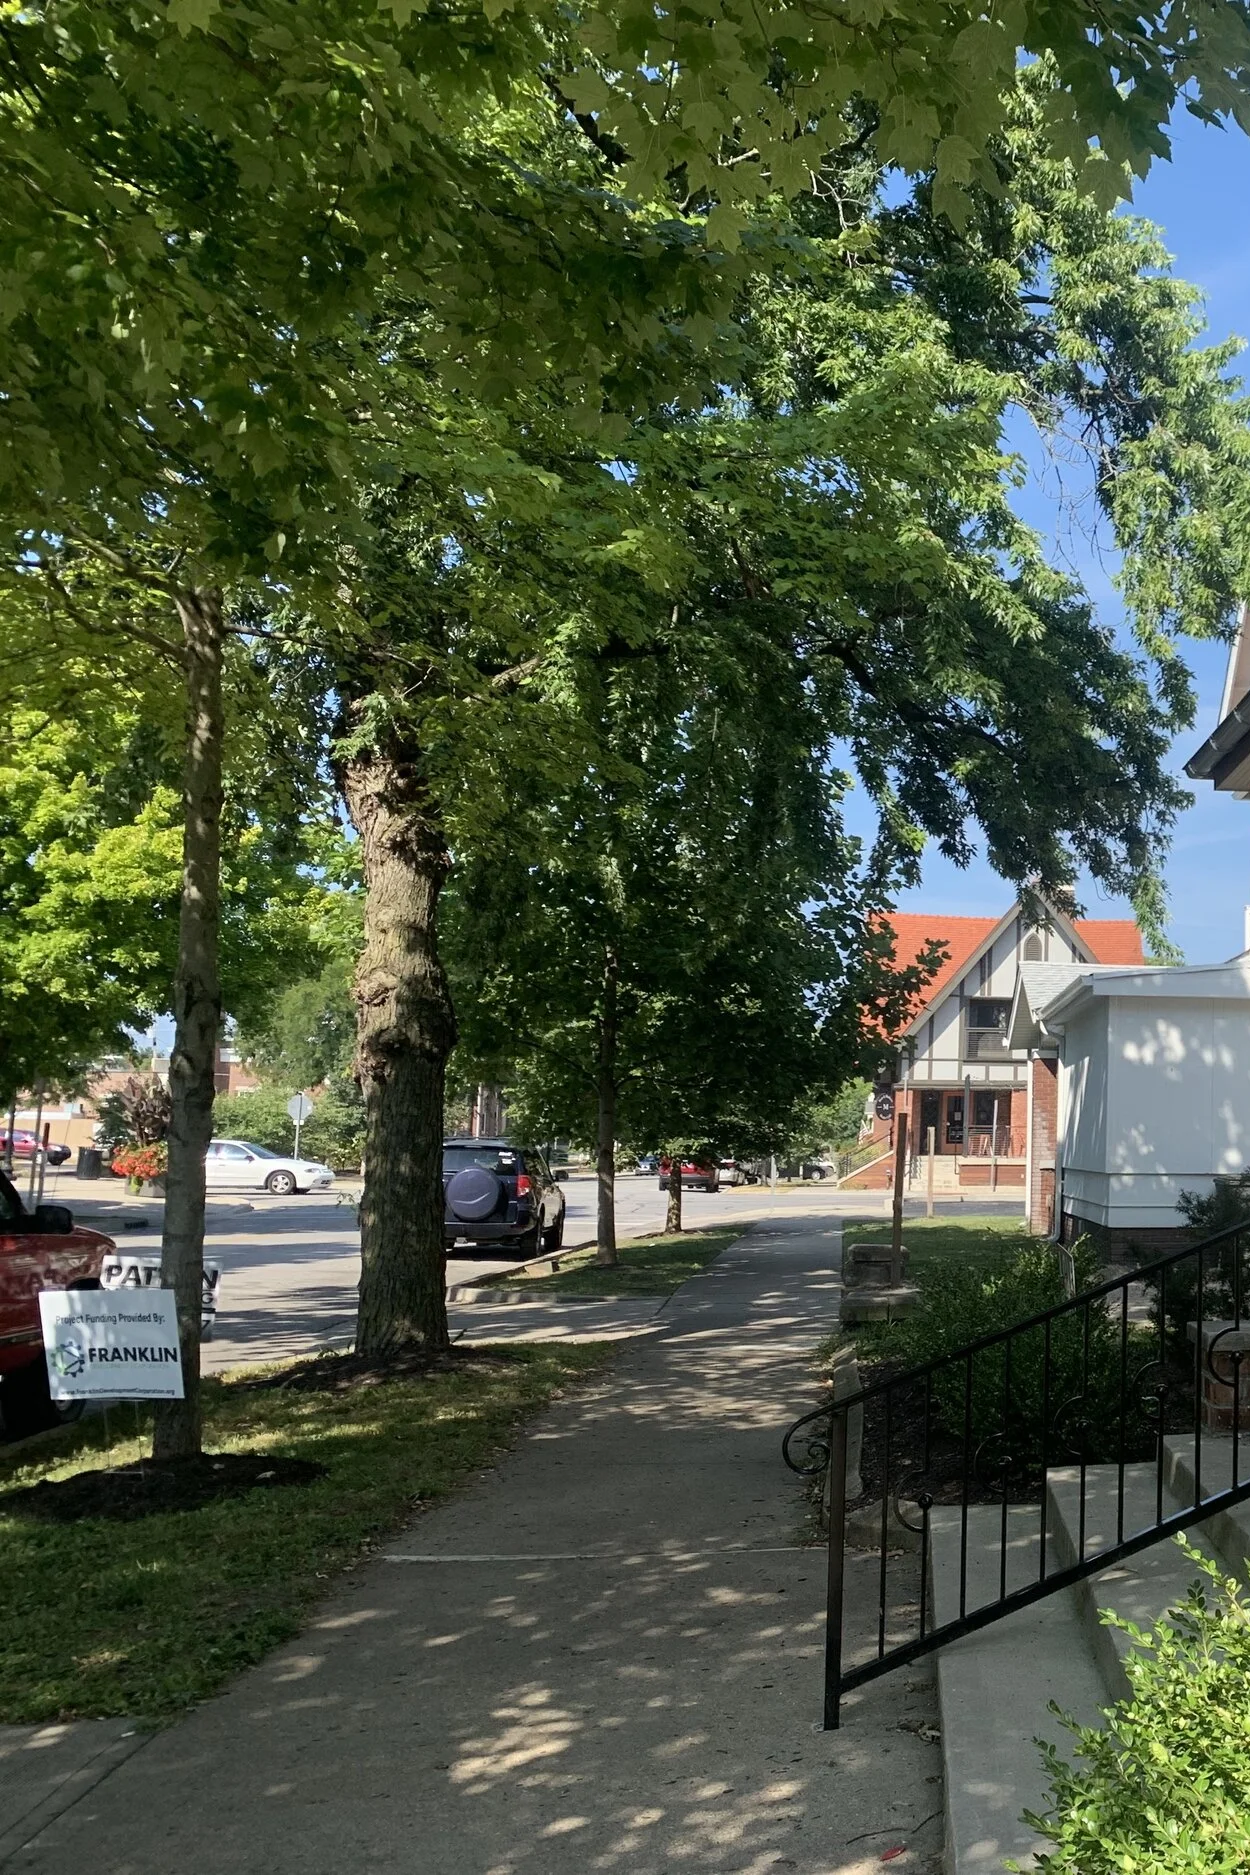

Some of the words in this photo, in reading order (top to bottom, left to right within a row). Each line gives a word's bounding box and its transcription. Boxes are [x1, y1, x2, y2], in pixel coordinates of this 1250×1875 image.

[105, 1264, 219, 1290] PATN
[55, 1314, 83, 1326] Project
[85, 1314, 117, 1325] Funding
[118, 1312, 152, 1323] Provided
[88, 1346, 178, 1363] FRANKLIN
